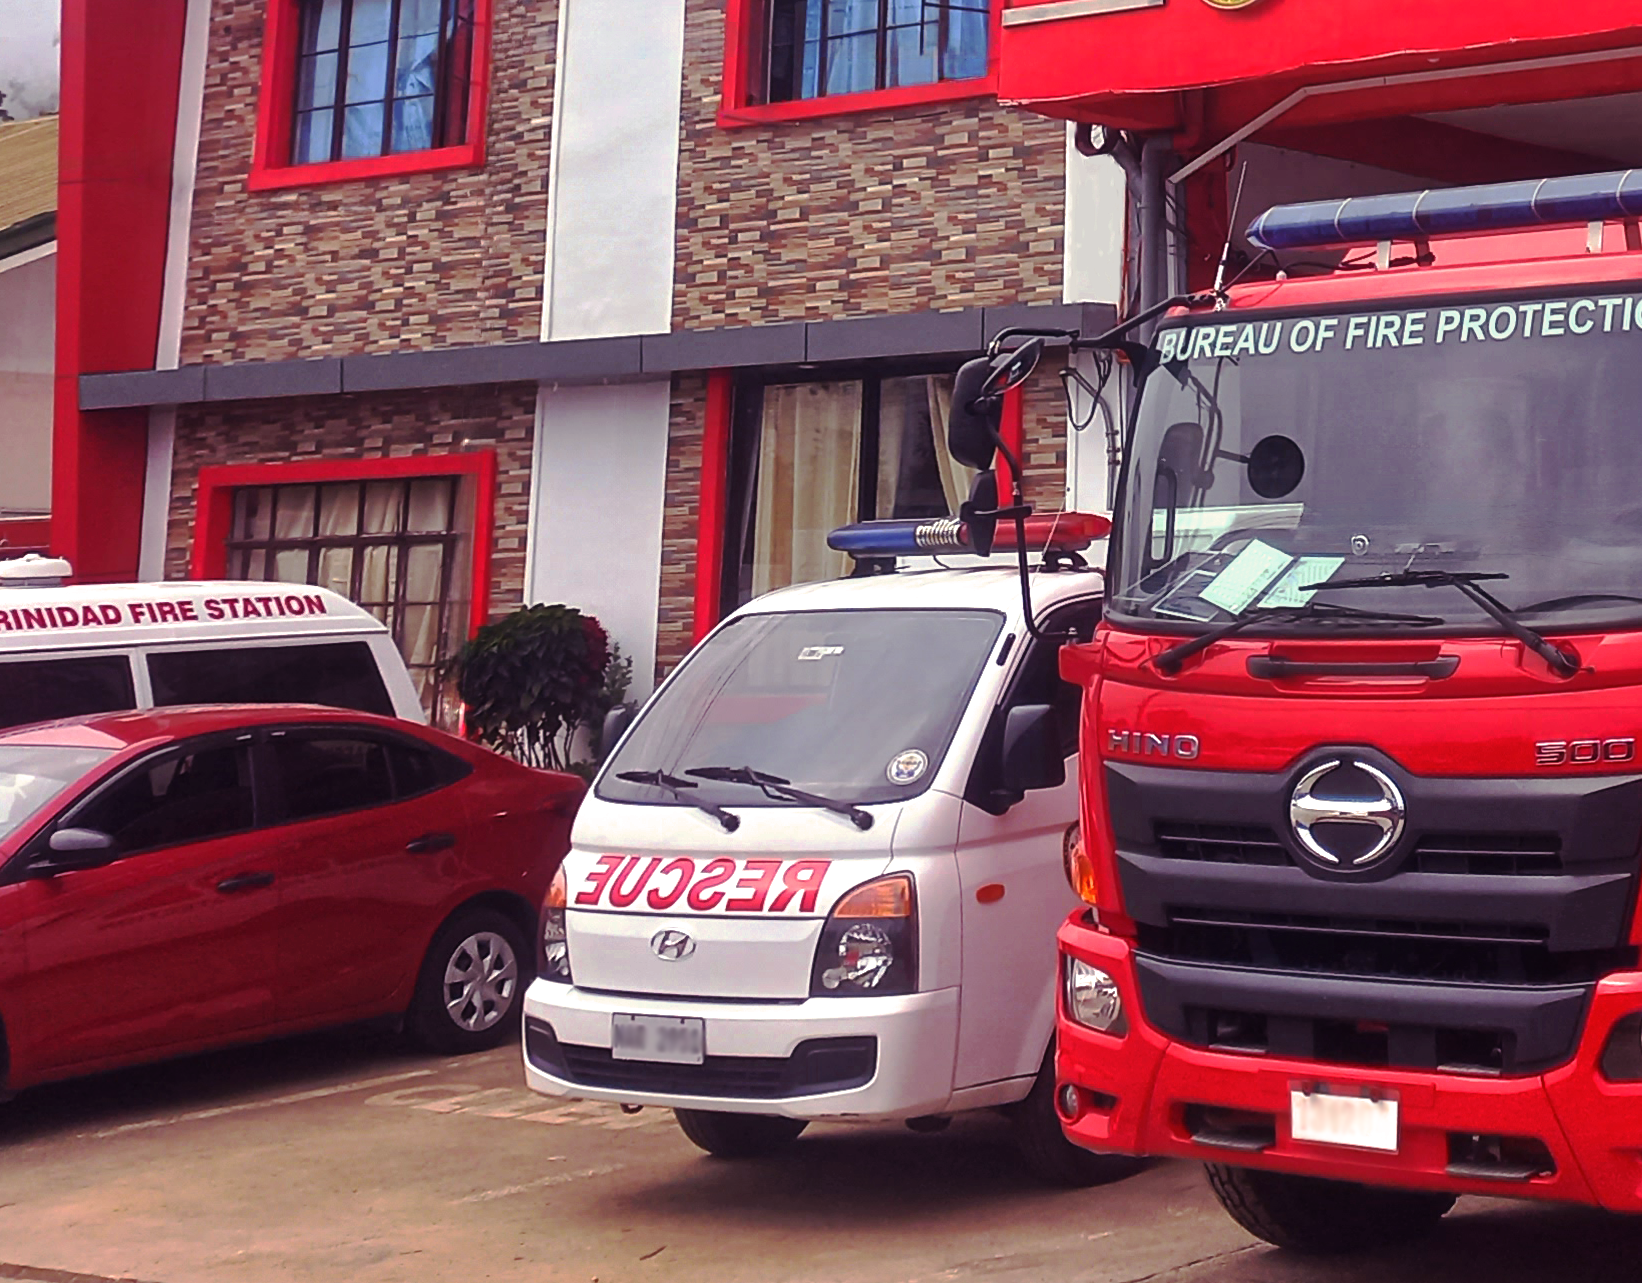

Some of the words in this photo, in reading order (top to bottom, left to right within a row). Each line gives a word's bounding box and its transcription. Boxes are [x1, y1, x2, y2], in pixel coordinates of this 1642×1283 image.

[1159, 322, 1283, 364] BUREAU
[1290, 318, 1339, 353] OF
[1345, 312, 1428, 350] FIRE
[127, 600, 199, 624] FIRE
[204, 594, 328, 620] STATION
[1107, 728, 1199, 760] HINO
[1535, 738, 1635, 766] 500
